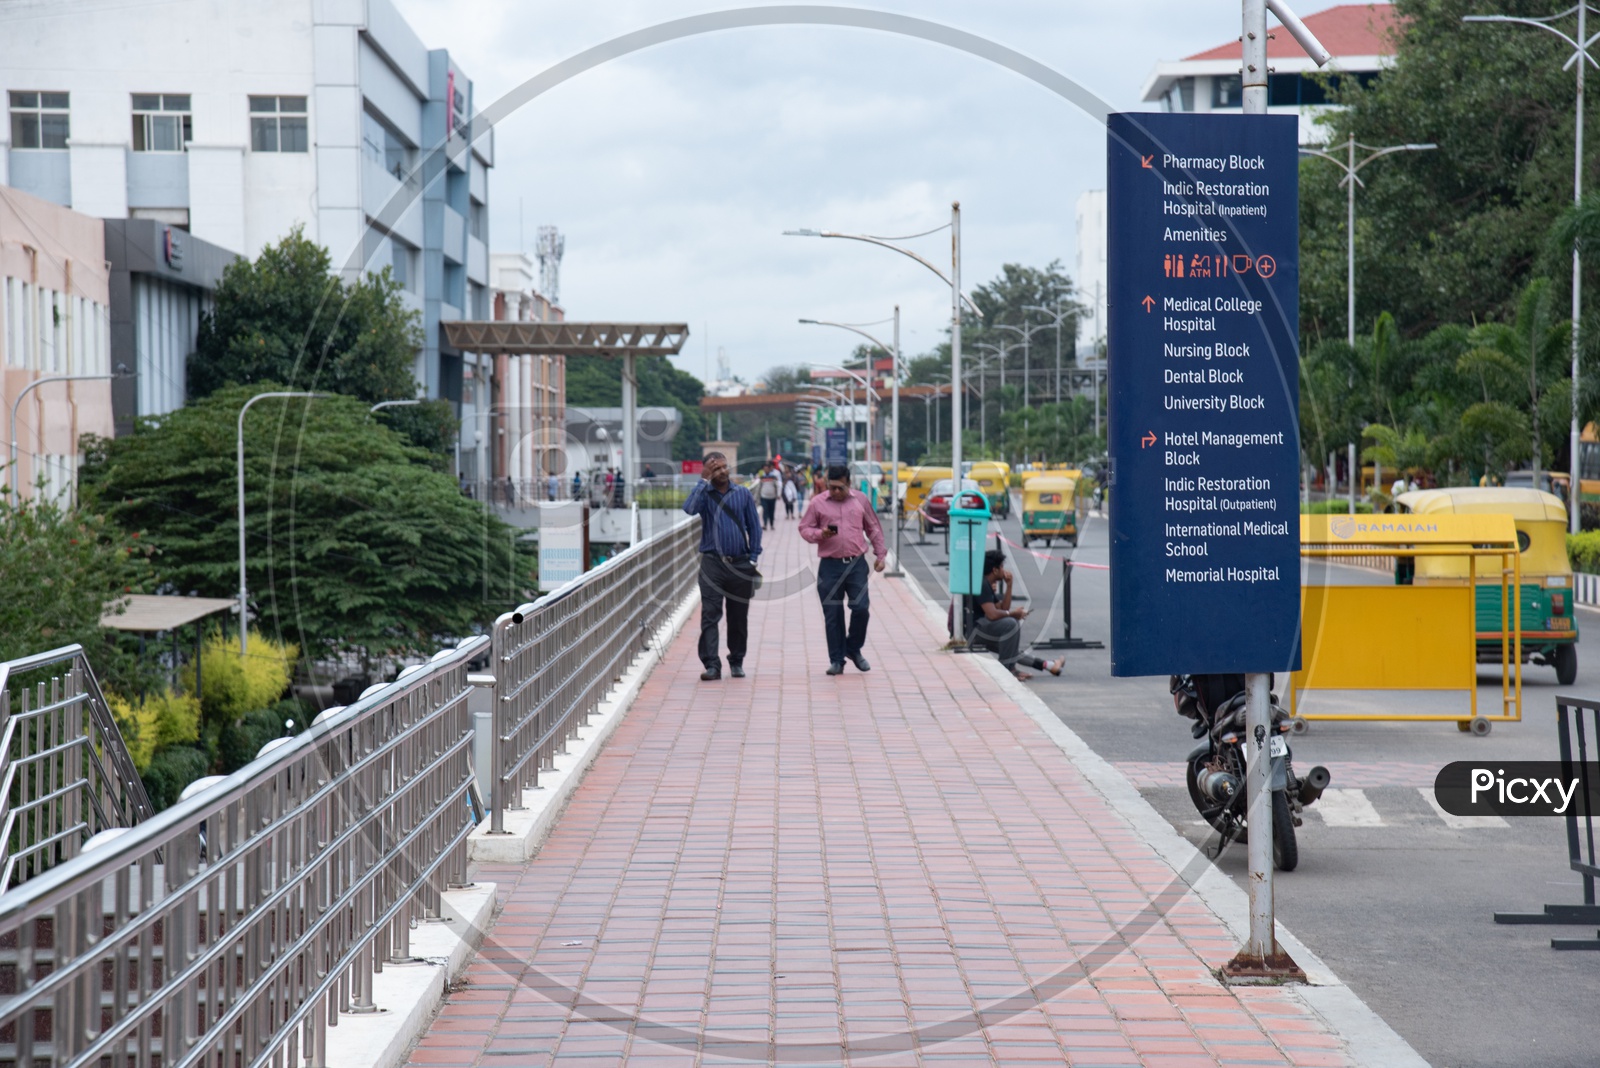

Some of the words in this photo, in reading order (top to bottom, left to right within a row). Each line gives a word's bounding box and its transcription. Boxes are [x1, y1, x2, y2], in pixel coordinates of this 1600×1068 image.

[1163, 153, 1227, 173] Pharmacy
[1229, 154, 1265, 170] Block
[1163, 180, 1194, 196] Indic
[1196, 180, 1270, 196] Restoration
[1163, 200, 1216, 218] Hospital
[1218, 204, 1267, 218] (Inpatient)
[1163, 226, 1227, 242] Amenities
[1189, 268, 1211, 278] ATM
[1163, 297, 1212, 312] Medical
[1214, 296, 1262, 315] College
[1164, 316, 1217, 334] Hospital
[1164, 342, 1212, 361] Nursing
[1215, 342, 1250, 357] Block
[1164, 368, 1206, 384] Dental
[1208, 368, 1244, 384] Block
[1164, 395, 1227, 413] University
[1229, 394, 1265, 410] Block
[1164, 431, 1199, 446] Hotel
[1201, 431, 1284, 449] Management
[1165, 450, 1200, 466] Block
[1165, 476, 1195, 492] Indic
[1197, 476, 1271, 491] Restoration
[1165, 495, 1218, 514] Hospital
[1219, 498, 1277, 512] (Outpatient)
[1165, 521, 1242, 537] International
[1243, 520, 1289, 536] Medical
[1357, 523, 1437, 533] RAMAIAH
[1165, 541, 1209, 557] School
[1165, 567, 1225, 583] Memorial
[1227, 566, 1280, 584] Hospital
